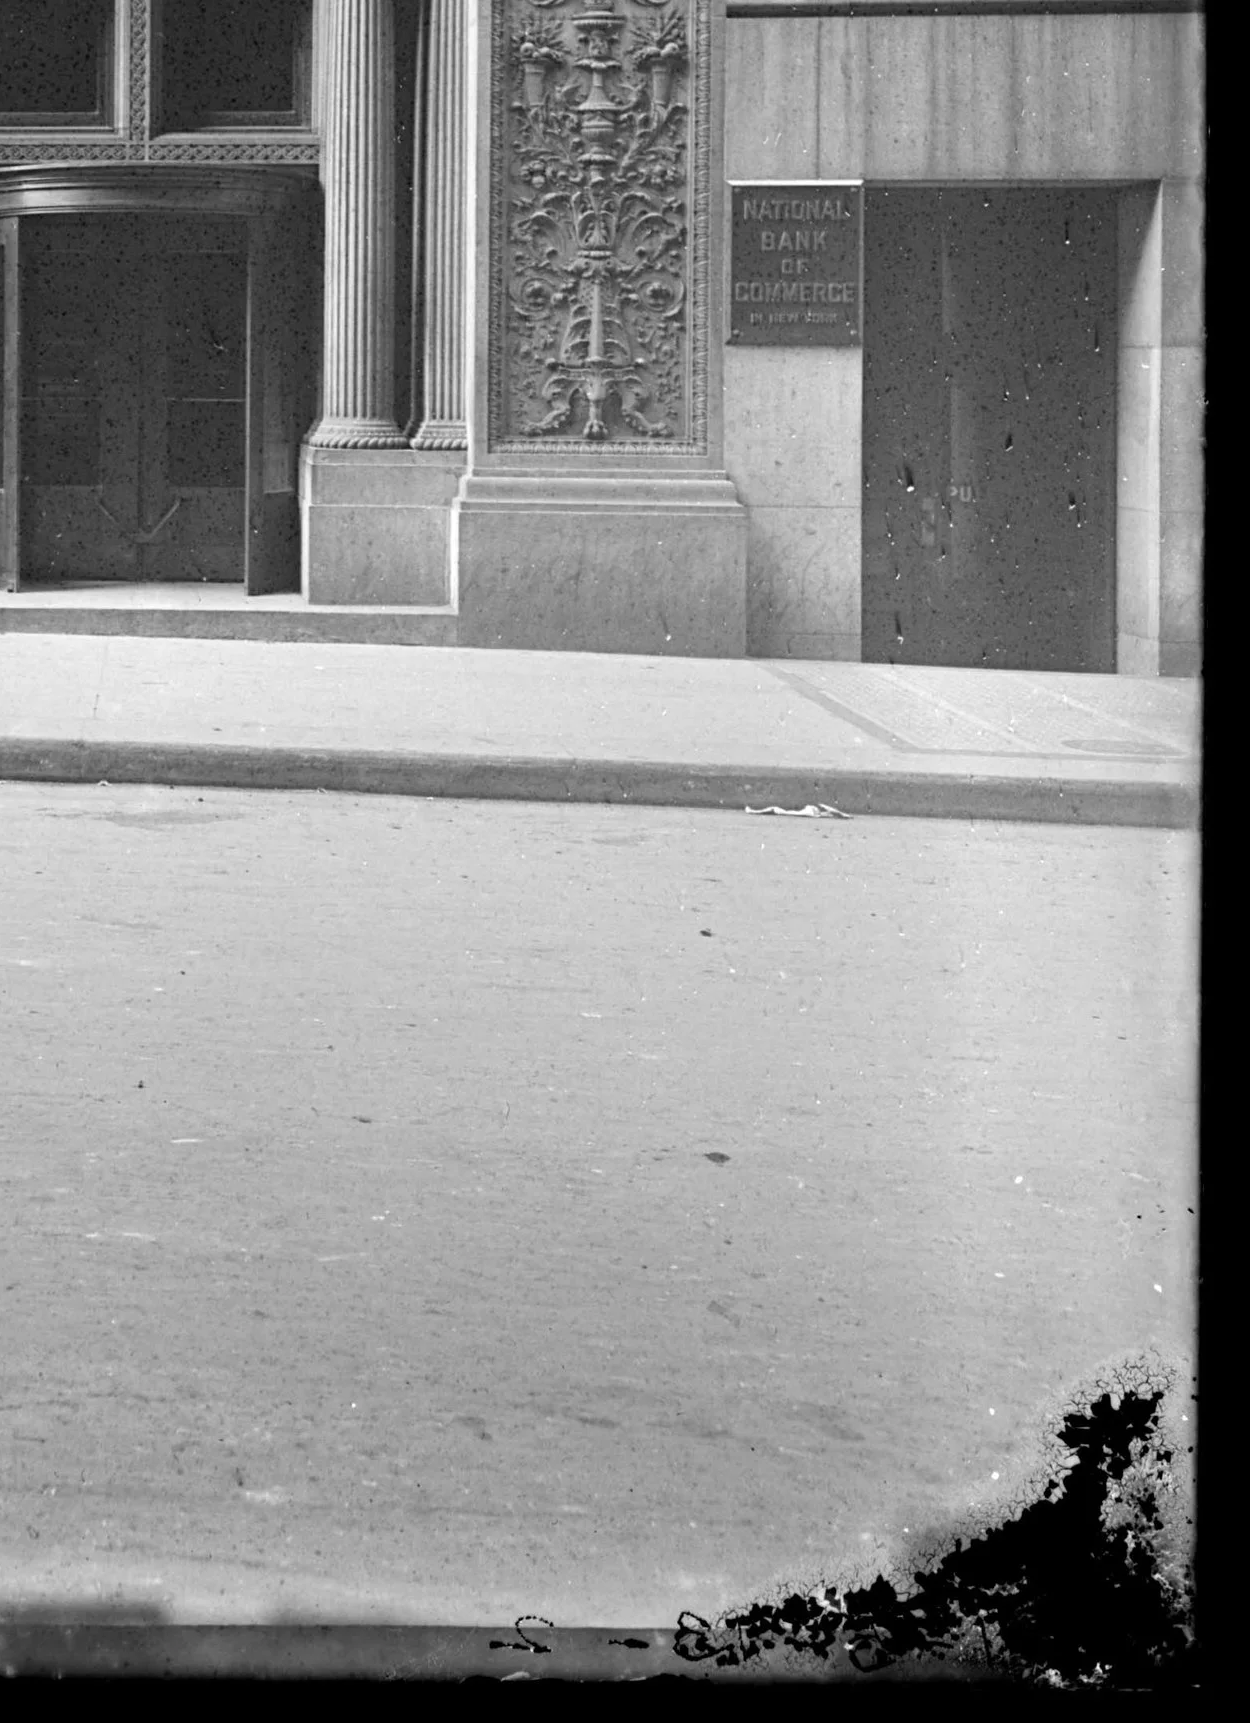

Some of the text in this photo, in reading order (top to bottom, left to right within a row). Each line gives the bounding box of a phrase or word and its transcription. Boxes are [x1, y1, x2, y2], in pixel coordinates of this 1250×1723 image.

[743, 199, 848, 220] NATIONAL
[761, 231, 827, 251] BANK
[781, 259, 809, 274] OF
[735, 282, 855, 302] COMMERCE
